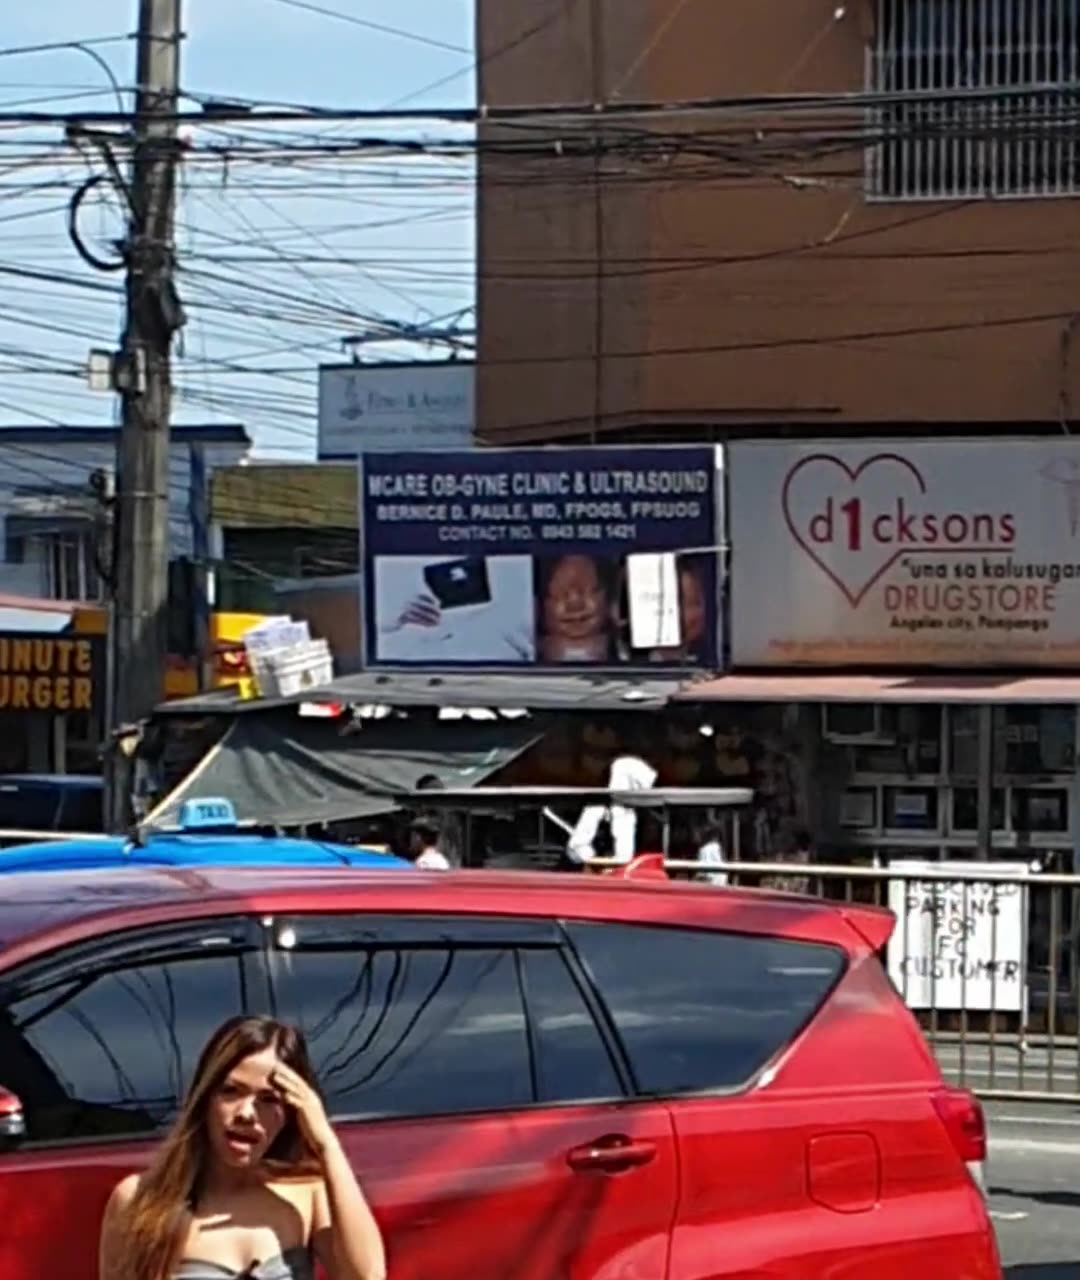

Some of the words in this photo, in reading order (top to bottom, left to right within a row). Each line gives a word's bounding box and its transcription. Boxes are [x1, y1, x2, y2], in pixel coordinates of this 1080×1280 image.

[431, 473, 509, 496] OB-GYNE
[512, 471, 571, 496] CLINIC
[574, 471, 587, 495] &
[589, 470, 708, 494] ULTRASOUND
[376, 504, 448, 521] BERNICE
[438, 525, 507, 541] CONTACT
[954, 563, 977, 579] sa
[884, 585, 1057, 612] DRUGSTORE
[890, 616, 944, 632] Angeles
[978, 616, 1049, 632] Pampanga
[906, 896, 1000, 917] PARKNG
